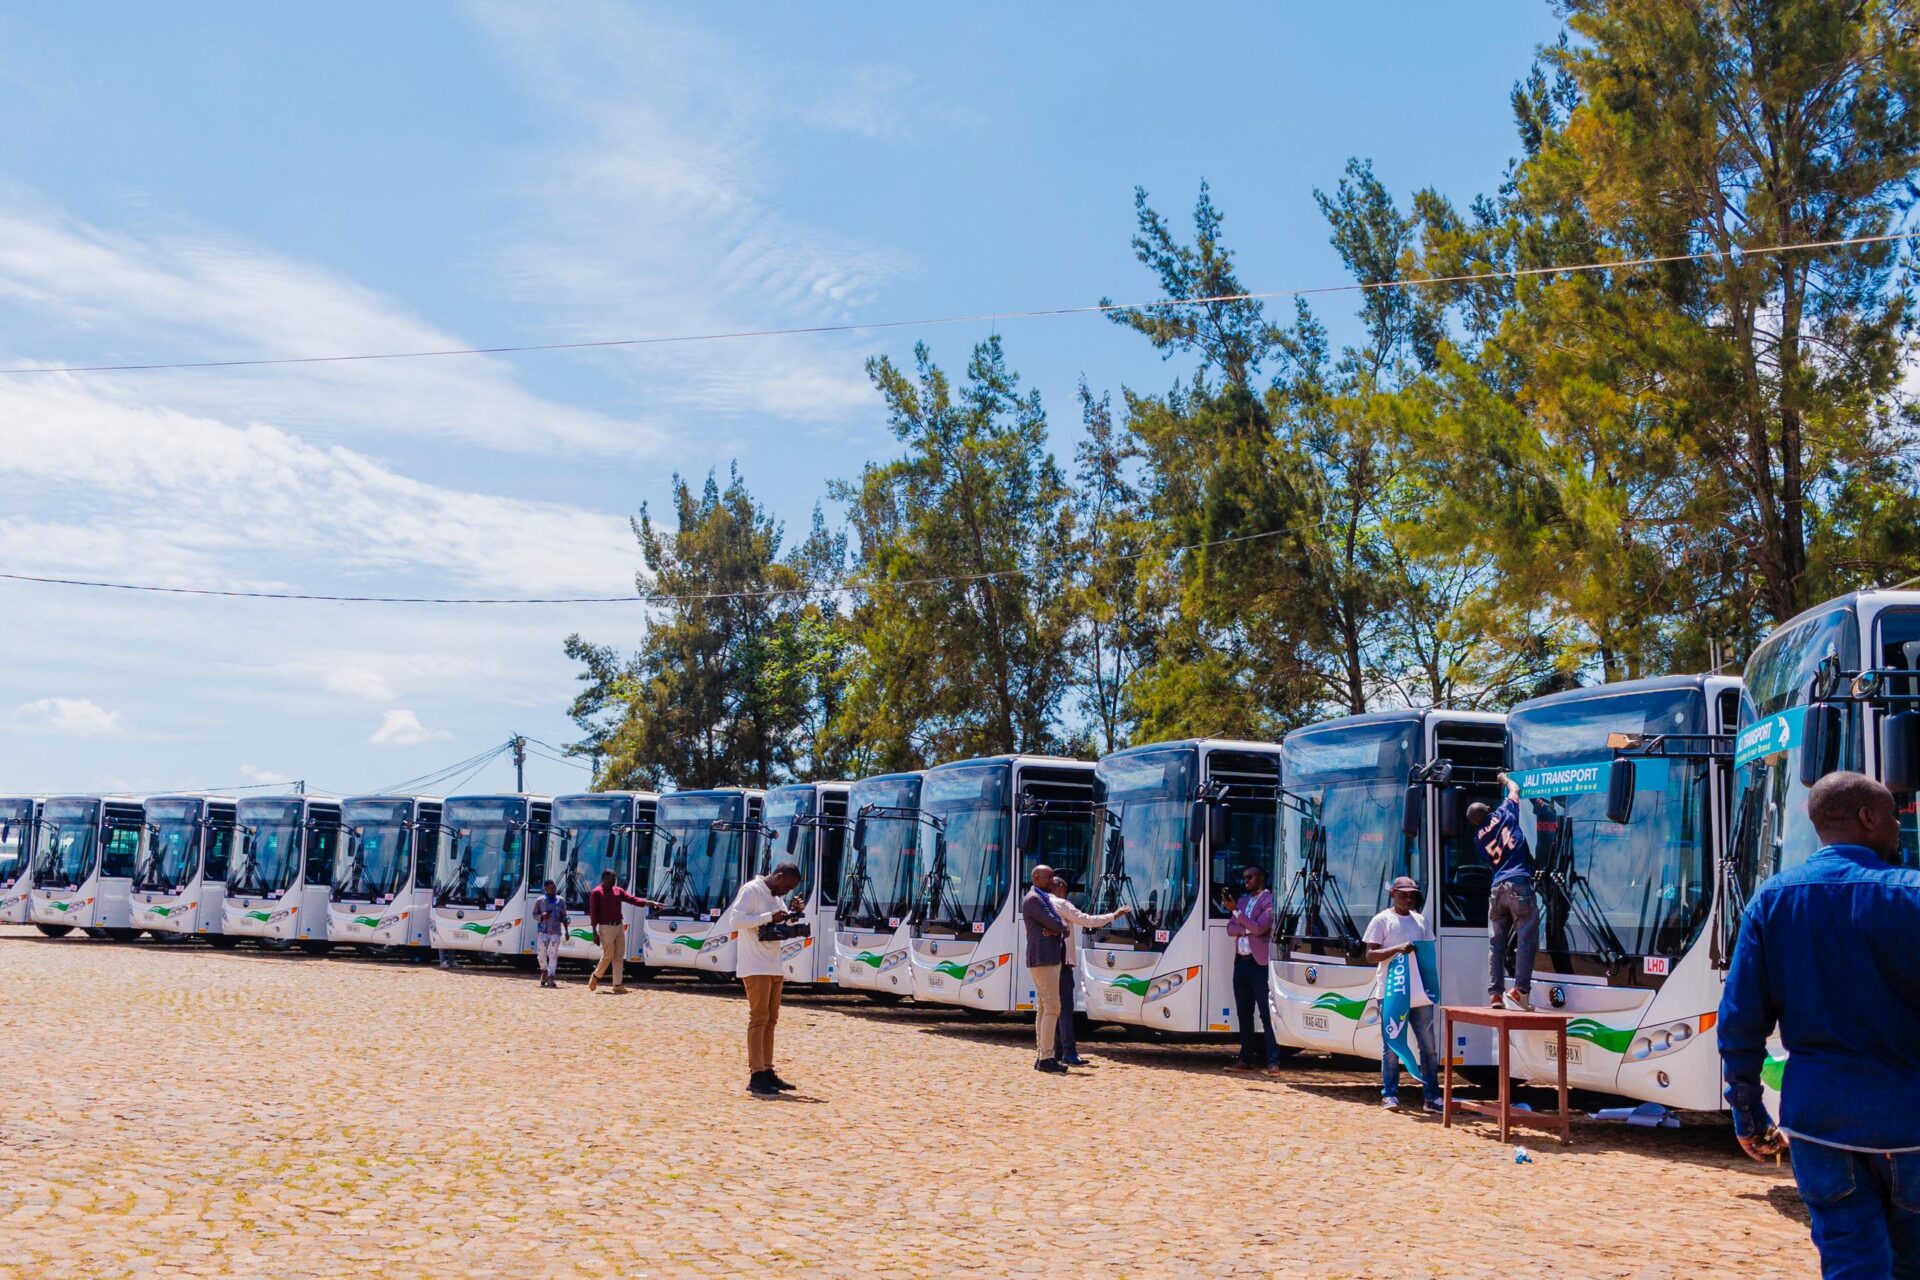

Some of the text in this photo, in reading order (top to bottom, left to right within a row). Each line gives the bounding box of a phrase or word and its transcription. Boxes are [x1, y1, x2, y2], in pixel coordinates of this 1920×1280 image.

[1523, 767, 1599, 788] JALI TRANSPORT
[1575, 783, 1597, 791] Brand
[1647, 958, 1665, 973] LHD
[1305, 1015, 1314, 1027] RAG
[1574, 1048, 1580, 1062] X
